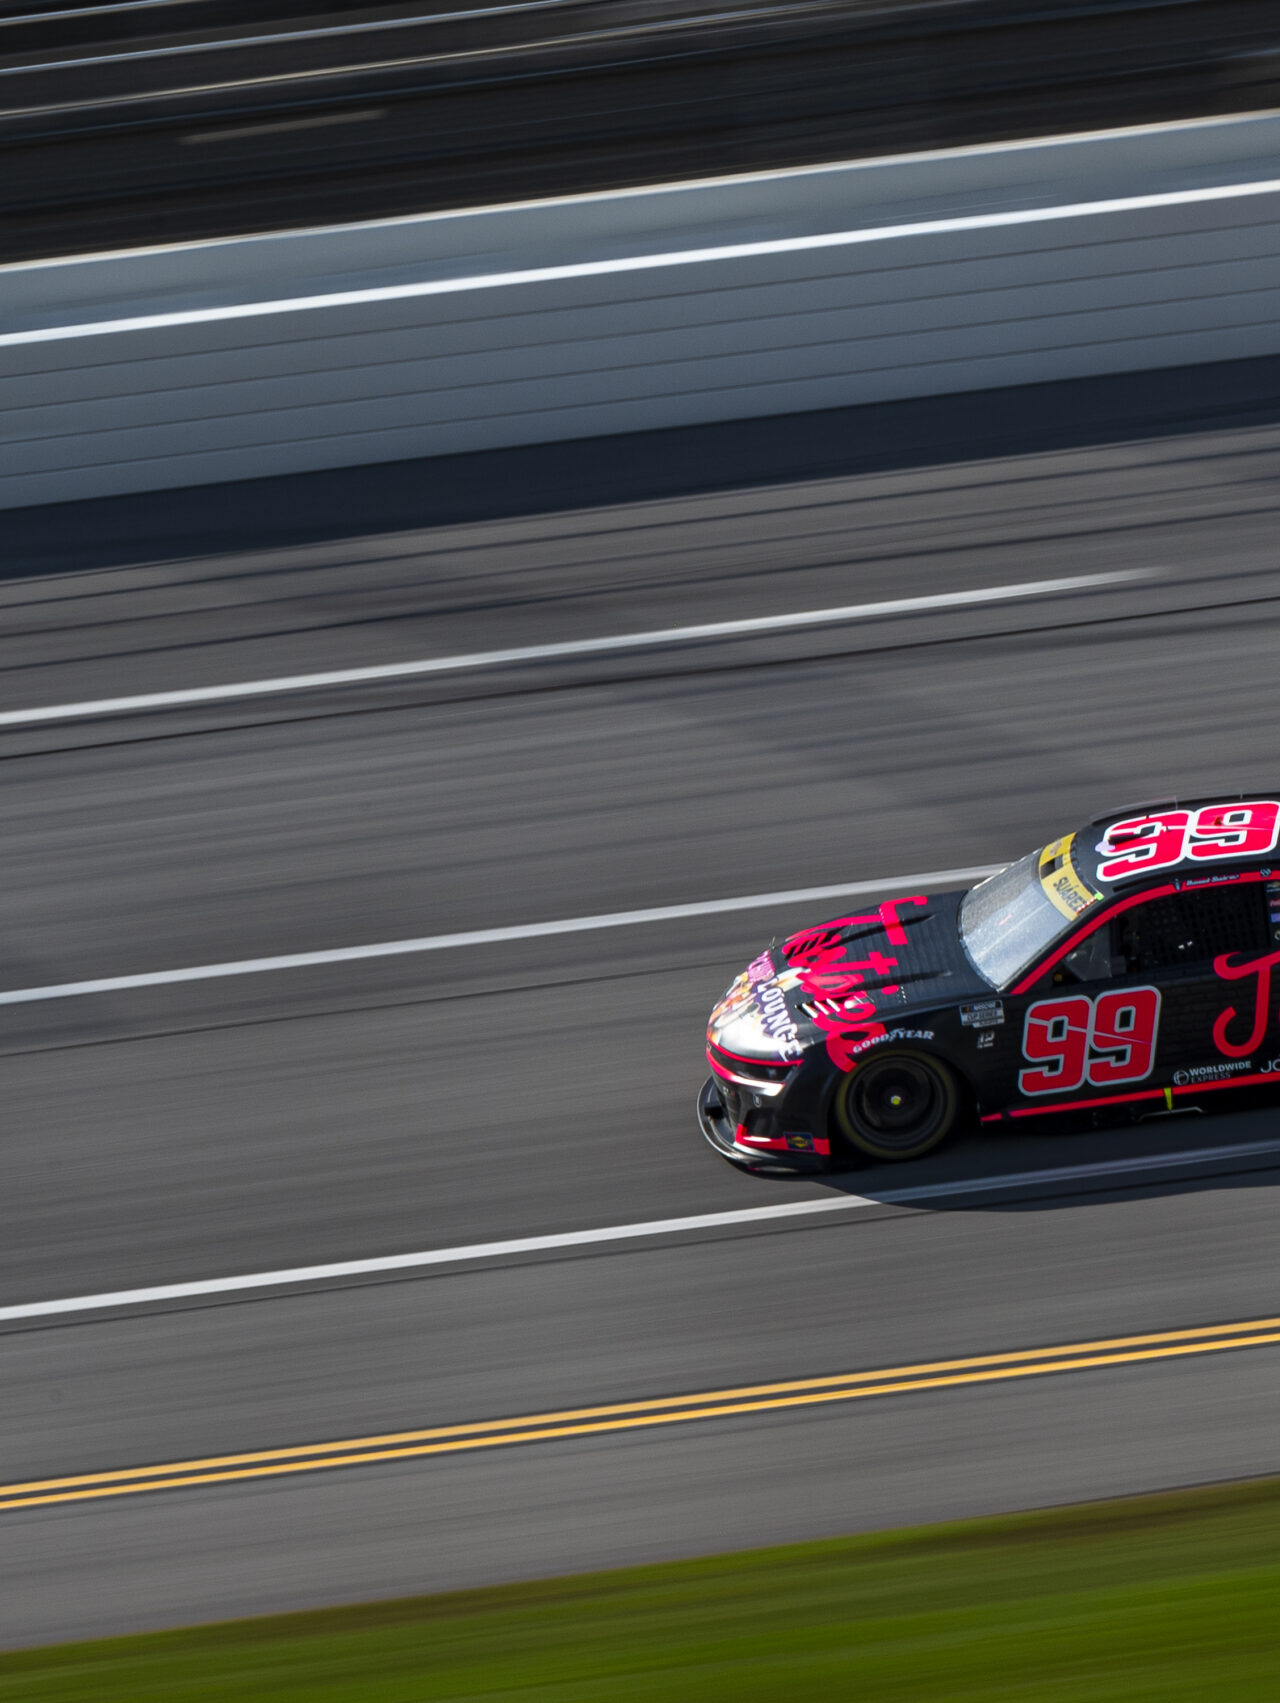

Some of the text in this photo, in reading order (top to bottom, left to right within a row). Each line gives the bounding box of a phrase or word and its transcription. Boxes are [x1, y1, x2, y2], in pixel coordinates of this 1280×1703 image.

[757, 977, 803, 1062] LOUNGE
[853, 1027, 935, 1054] GOODYEAR
[1018, 985, 1161, 1097] 99
[1189, 1060, 1253, 1077] WORLDWIDE
[1190, 1071, 1232, 1084] EXPRESS
